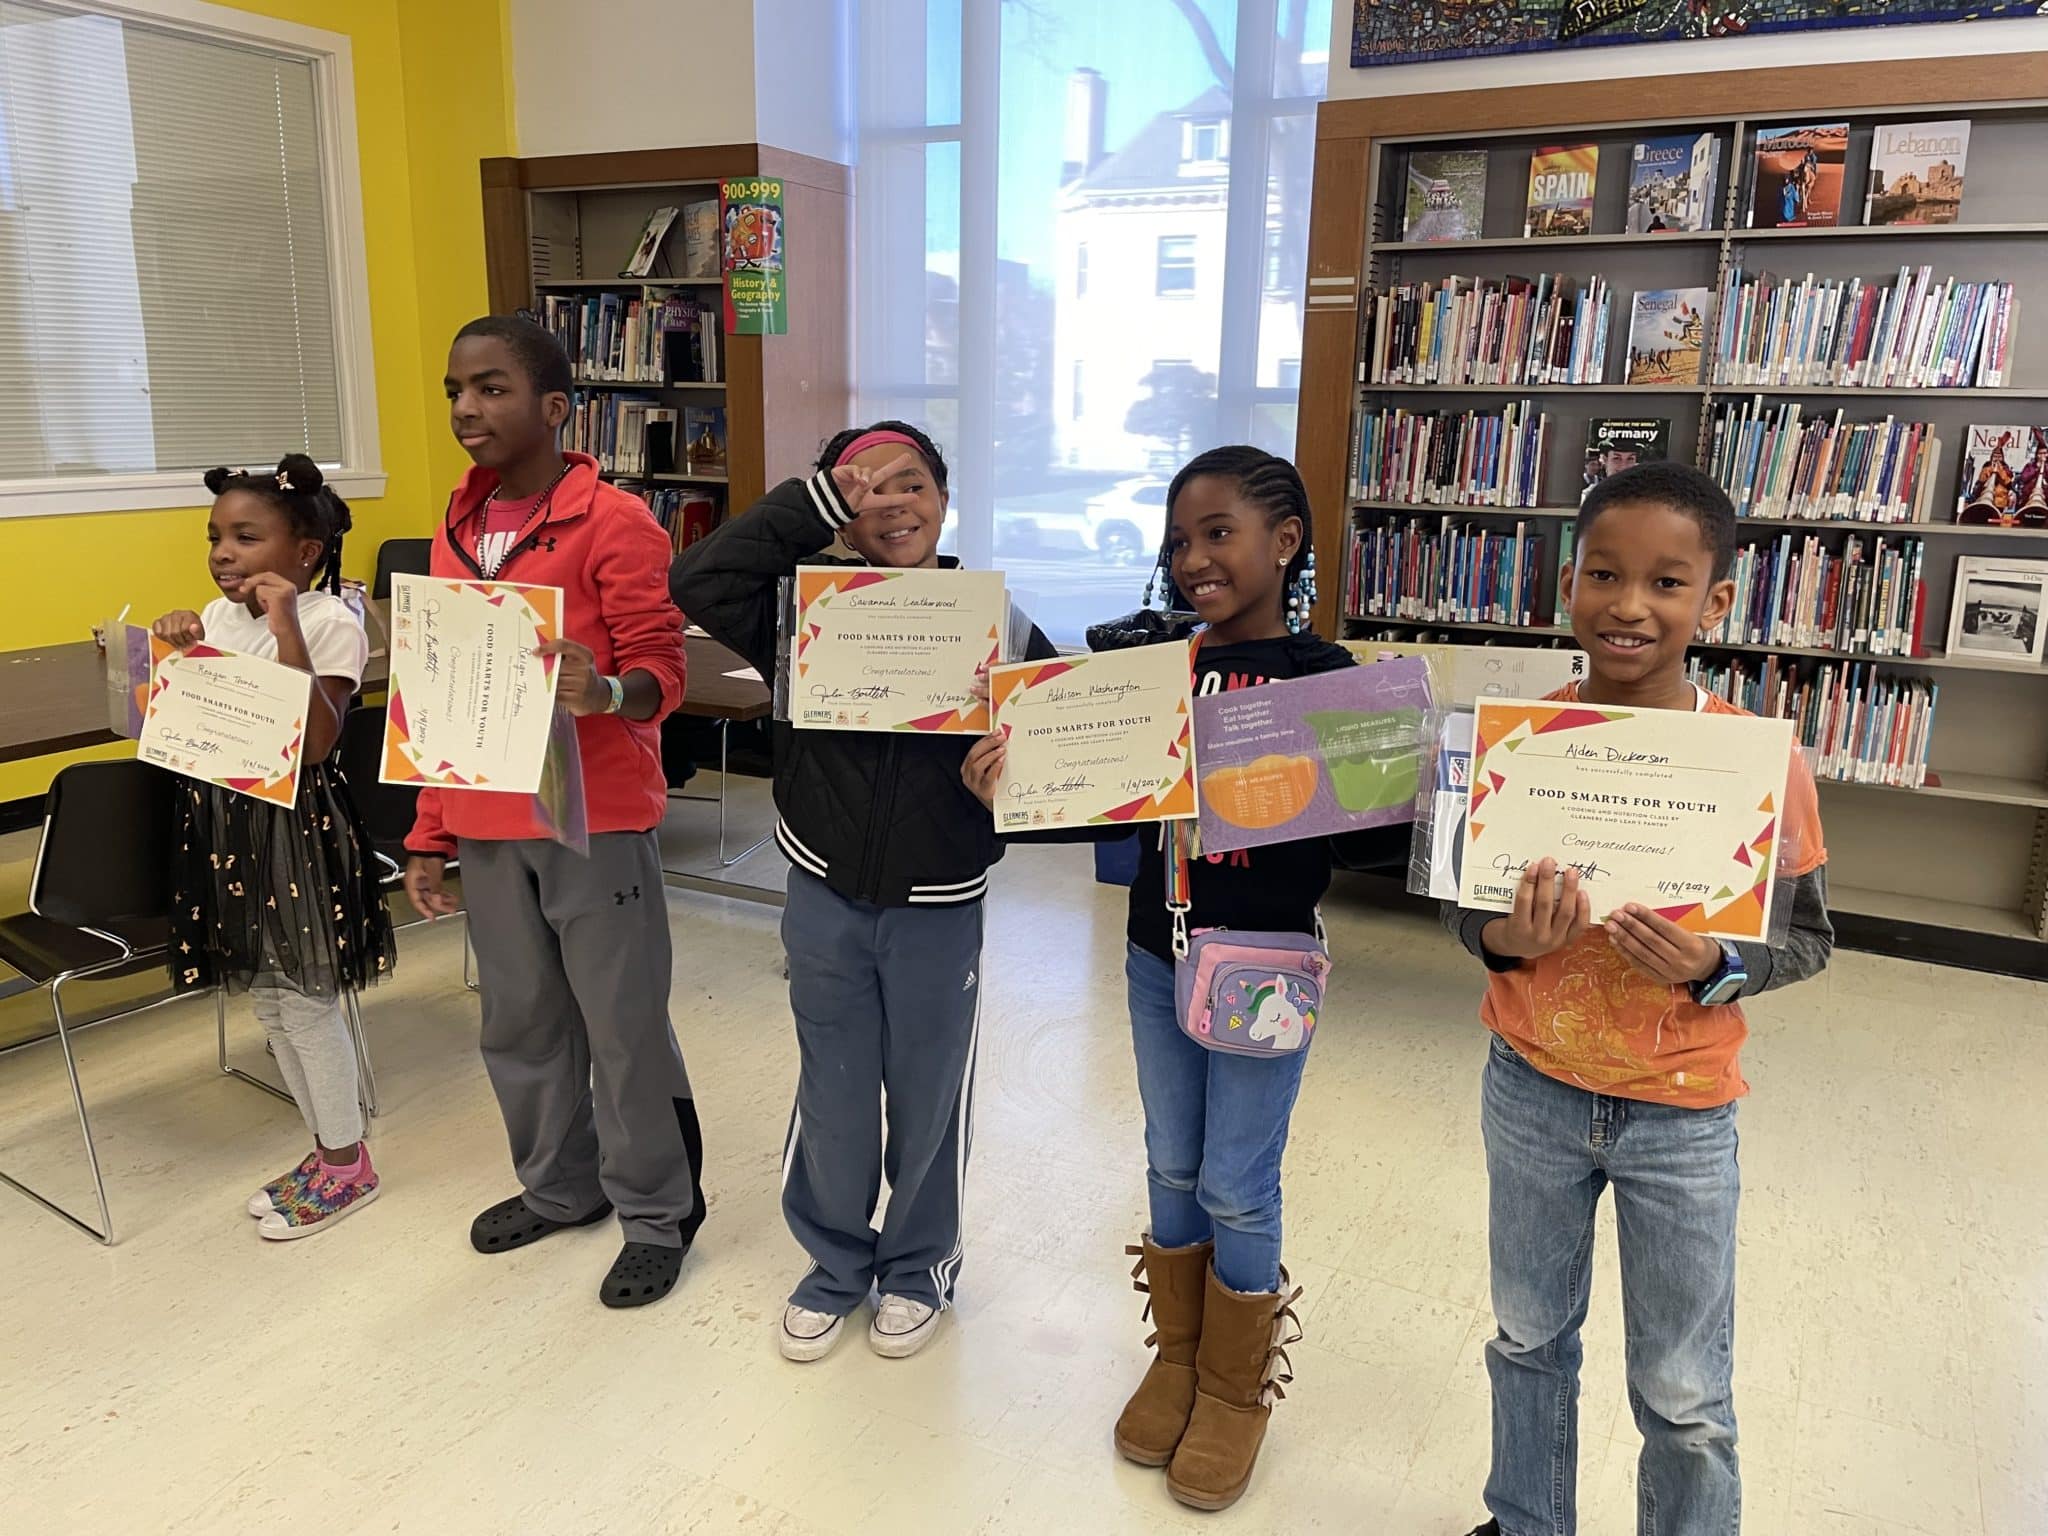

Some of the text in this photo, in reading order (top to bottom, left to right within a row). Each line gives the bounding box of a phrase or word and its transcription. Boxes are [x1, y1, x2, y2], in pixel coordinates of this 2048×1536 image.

[1885, 131, 1960, 155] Lebanon
[722, 182, 780, 199] 900-999
[1534, 172, 1590, 201] SPAIN
[733, 278, 777, 289] History &
[731, 289, 780, 303] Geography
[1638, 294, 1678, 313] Senegal
[1598, 427, 1659, 442] Germany
[1973, 429, 2021, 449] Neal
[849, 594, 958, 608] Savannah Leatherwood
[837, 633, 962, 643] FOOD SMARTS FOR YOUTH
[484, 652, 494, 691] SMARTS
[862, 665, 937, 678] Congratulations!
[1572, 655, 1584, 675] 3M
[1047, 680, 1141, 703] Addison Washington
[181, 690, 202, 702] FOOD
[203, 697, 233, 711] SMARTS
[234, 705, 248, 716] FOR
[251, 711, 275, 725] YOUTH
[482, 694, 490, 713] FOR
[1218, 700, 1274, 715] Cook together.
[803, 710, 832, 720] GLEANERS
[1223, 709, 1271, 723] Eat together.
[1028, 727, 1053, 737] FOOD
[1056, 722, 1094, 734] SMARTS
[1098, 720, 1116, 729] FOR
[1119, 716, 1152, 726] YOUTH
[1223, 724, 1239, 733] Talk
[1360, 717, 1397, 730] MEASURES
[476, 716, 486, 748] YOUTH
[1207, 740, 1225, 749] Make
[1565, 743, 1670, 764] Aiden Dickerson
[1054, 755, 1129, 770] Congratulations!
[1591, 766, 1632, 777] successfully
[1635, 770, 1673, 780] completed
[1529, 787, 1718, 814] FOOD SMARTS FOR YOUTH
[1003, 811, 1029, 822] GLEANERS
[1567, 806, 1596, 815] COOKING
[1613, 811, 1648, 819] NUTRITION
[1570, 814, 1602, 822] GLEANERS
[1561, 832, 1675, 856] Congratulations!
[1473, 884, 1512, 899] GLEANERS
